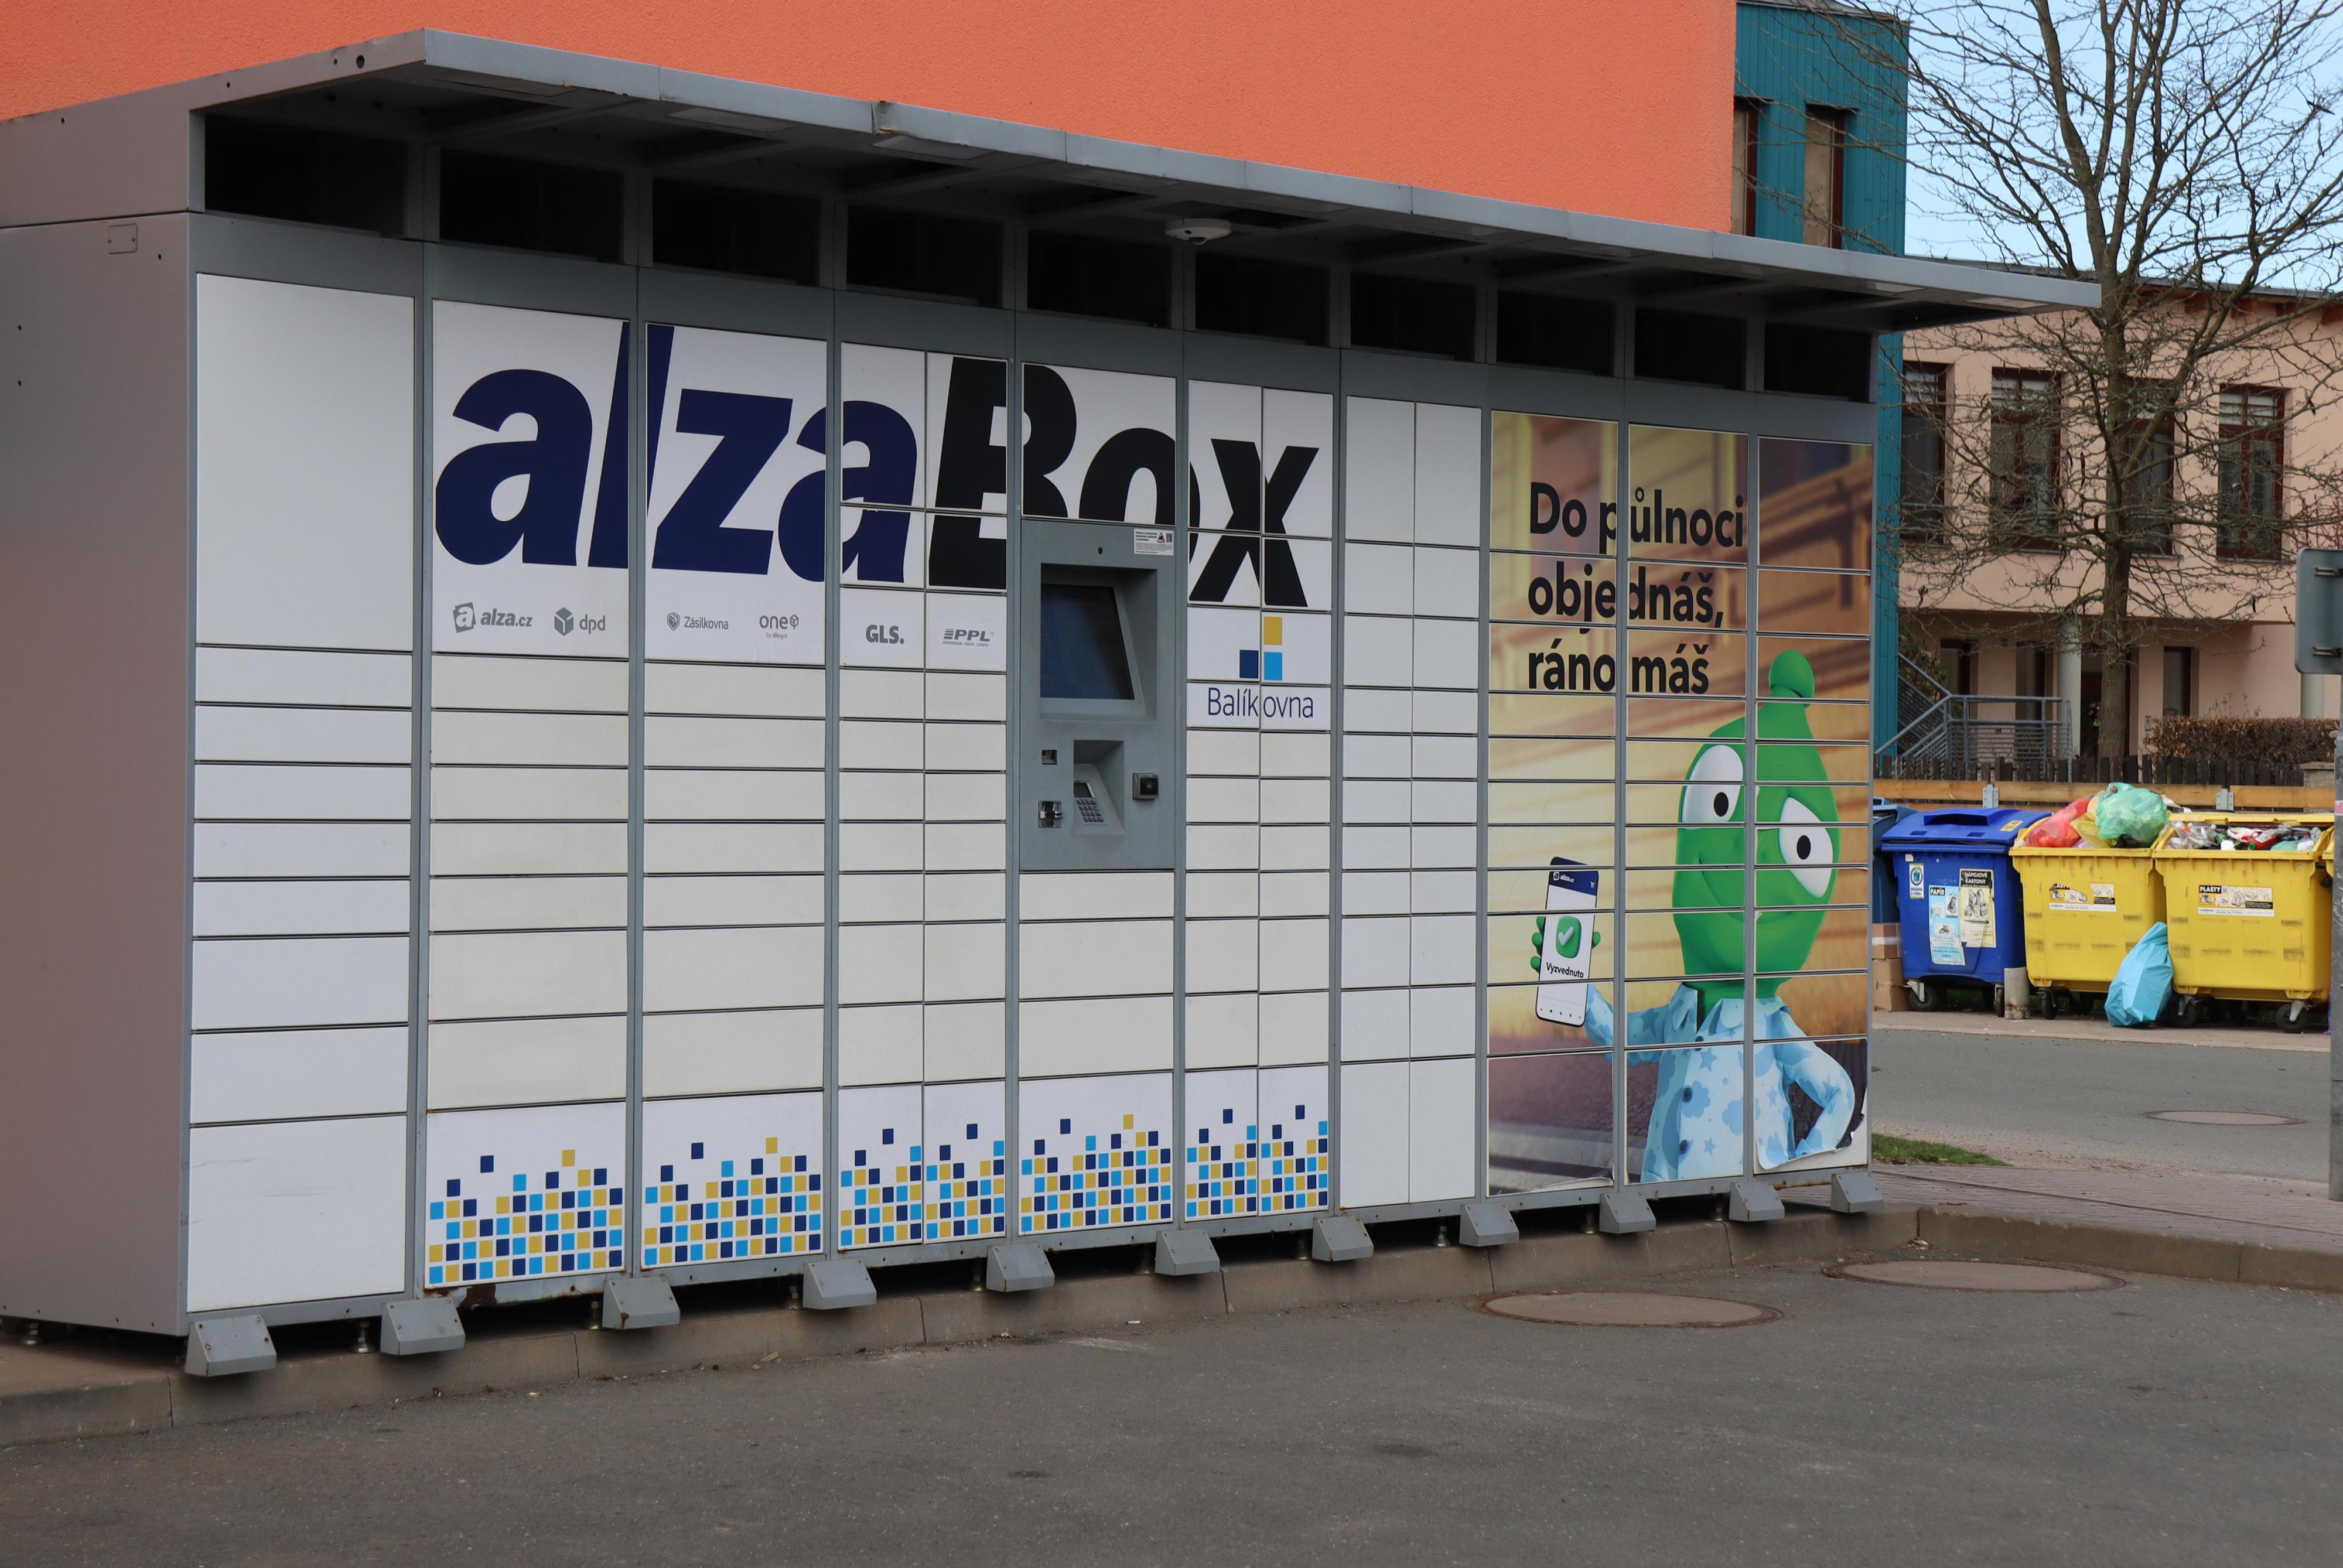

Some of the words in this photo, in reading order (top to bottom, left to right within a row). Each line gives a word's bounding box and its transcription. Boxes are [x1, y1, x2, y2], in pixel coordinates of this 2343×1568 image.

[435, 321, 1319, 607] alzaBox
[1529, 481, 1587, 538] Do
[1599, 487, 1744, 555] půlnoci
[1528, 561, 1724, 634] objednáš,
[480, 608, 533, 627] alza.cz
[579, 614, 606, 635] dpd
[684, 616, 729, 630] Zásilkovna
[759, 615, 788, 630] one
[1528, 638, 1615, 692] ráno
[1631, 643, 1709, 695] máš
[1207, 687, 1314, 718] Balíkovna
[1546, 962, 1584, 979] Vyzvednuto
